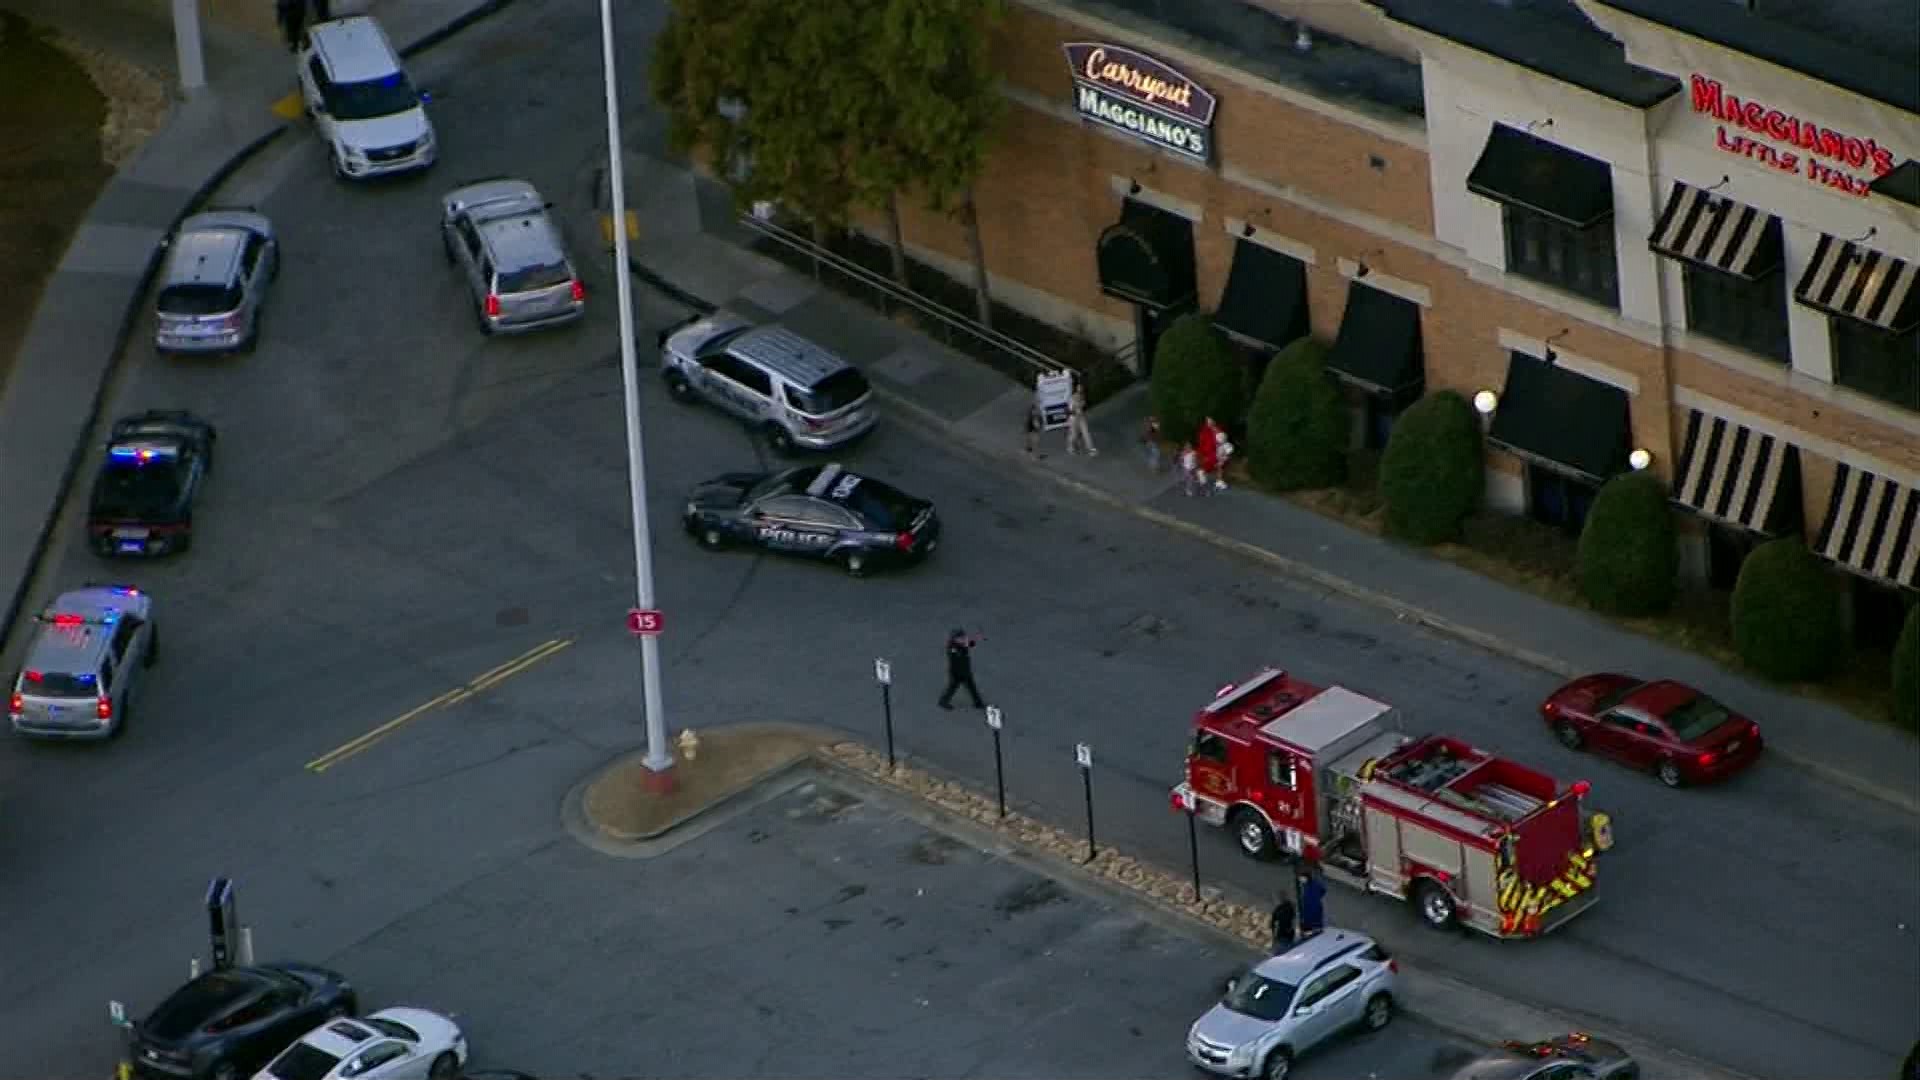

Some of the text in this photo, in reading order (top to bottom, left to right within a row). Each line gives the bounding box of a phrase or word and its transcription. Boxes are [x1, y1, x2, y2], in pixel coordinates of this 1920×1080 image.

[1086, 48, 1192, 107] Carryout
[1079, 86, 1204, 153] MAGGIANO'S
[1690, 72, 1895, 178] MAGGIANO'S
[1716, 125, 1800, 175] LITTLE
[636, 614, 657, 630] 15
